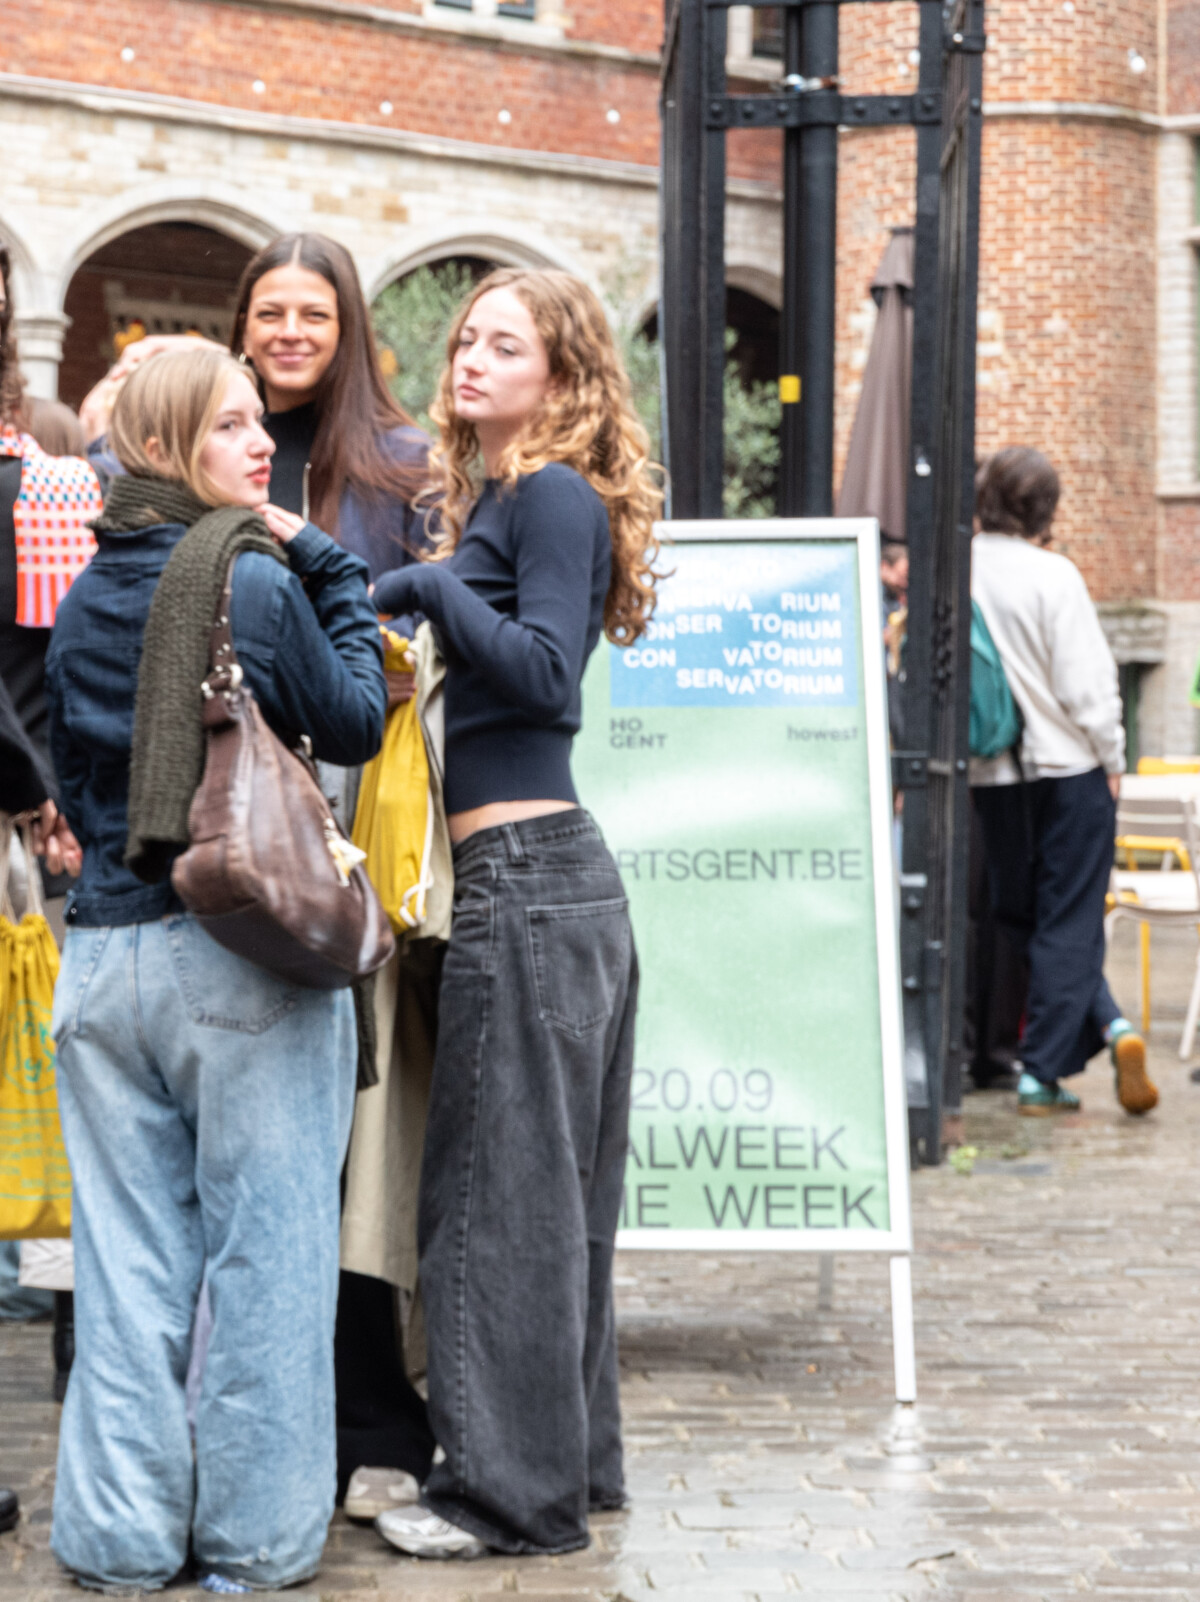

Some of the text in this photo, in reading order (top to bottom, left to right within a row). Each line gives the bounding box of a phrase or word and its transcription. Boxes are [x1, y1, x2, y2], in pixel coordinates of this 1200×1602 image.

[780, 591, 842, 613] RIUM
[645, 612, 843, 641] ONSER TORIUM
[622, 640, 844, 669] CON VATORIUM
[674, 667, 846, 696] SERVATORIUM
[609, 717, 644, 733] HO
[786, 724, 859, 743] howest
[609, 733, 668, 750] GENT
[702, 1183, 878, 1230] WEEK
